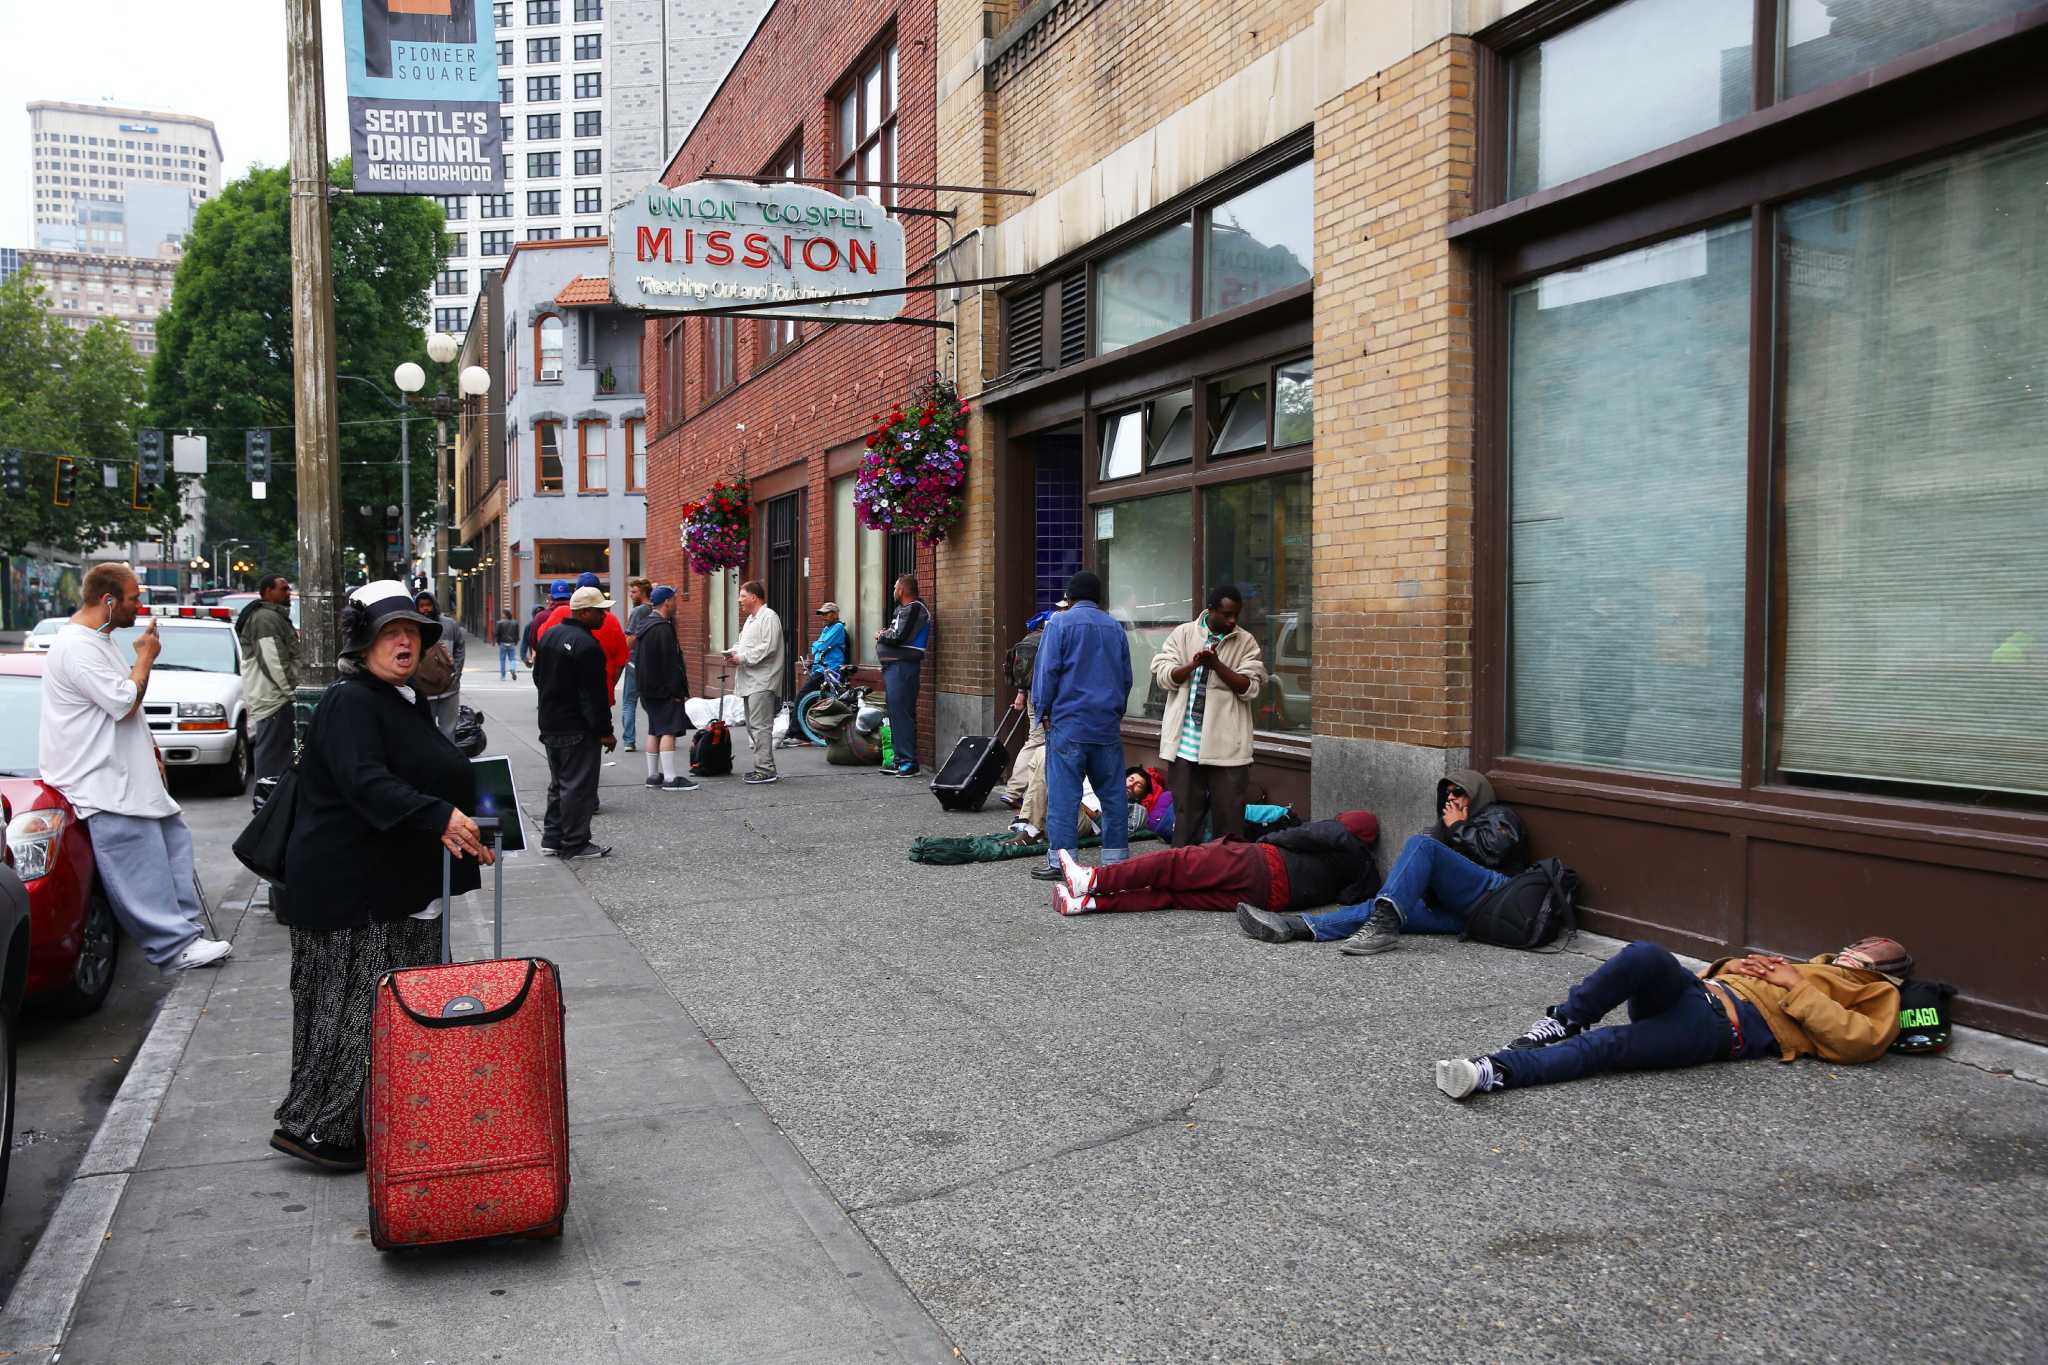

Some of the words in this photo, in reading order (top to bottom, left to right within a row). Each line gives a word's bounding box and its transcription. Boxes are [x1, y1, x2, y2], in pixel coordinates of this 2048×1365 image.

[397, 46, 476, 63] PIONEER
[399, 65, 478, 82] SQUARE
[365, 108, 488, 135] SEATTLE'S
[367, 134, 491, 163] ORIGINAL
[368, 163, 492, 182] NEIGHBORHOOD
[648, 194, 736, 221] UNION
[762, 203, 873, 230] GOSPEL
[636, 226, 878, 275] MISSION
[1898, 1007, 1940, 1029] HICAGO
